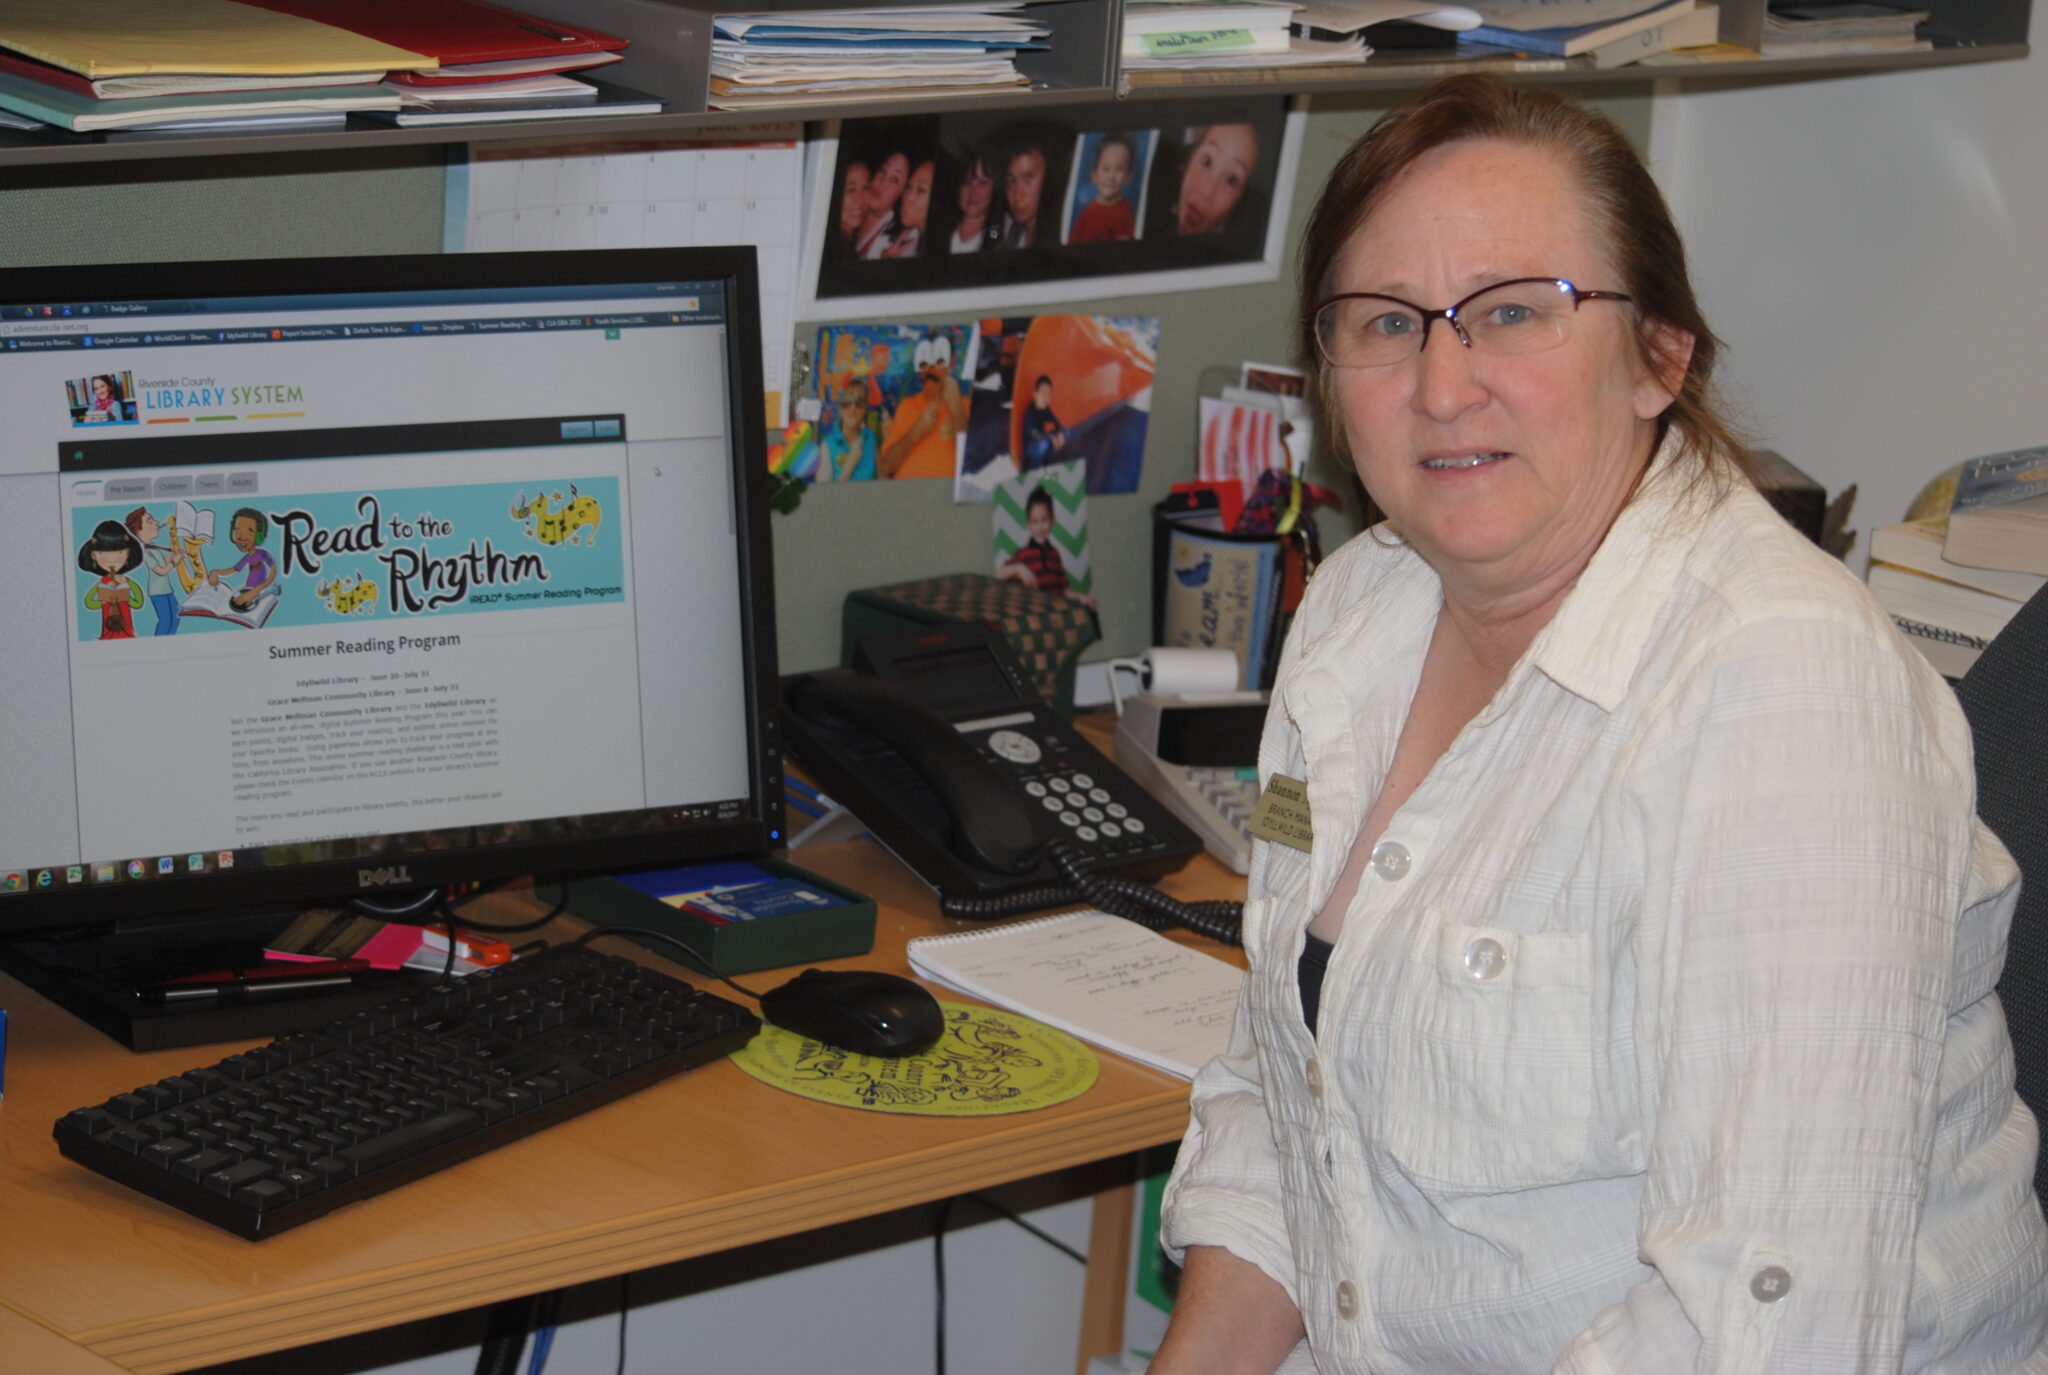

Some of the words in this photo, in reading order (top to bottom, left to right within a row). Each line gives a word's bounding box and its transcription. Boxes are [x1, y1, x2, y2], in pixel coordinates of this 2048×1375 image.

[139, 377, 180, 390] Riverside
[181, 376, 216, 388] County
[146, 387, 225, 409] LIBRARY
[231, 384, 304, 405] SYSTEM
[159, 482, 187, 491] Children
[271, 495, 386, 576] Read
[388, 514, 414, 539] to
[416, 512, 453, 538] the
[378, 539, 549, 613] Rhythm
[505, 591, 541, 602] Summer
[543, 588, 582, 600] Reading
[584, 586, 622, 597] Program
[268, 644, 332, 660] Summer
[335, 638, 396, 656] Reading
[398, 633, 462, 652] Program
[331, 675, 359, 685] Library
[370, 673, 388, 682] June
[267, 698, 289, 707] Grace
[324, 691, 367, 702] Community
[369, 690, 395, 700] Library
[405, 687, 421, 695] June
[260, 715, 282, 723] Grace
[319, 708, 362, 718] Community
[365, 706, 392, 716] Library
[460, 697, 486, 707] Library
[358, 865, 413, 888] DELL
